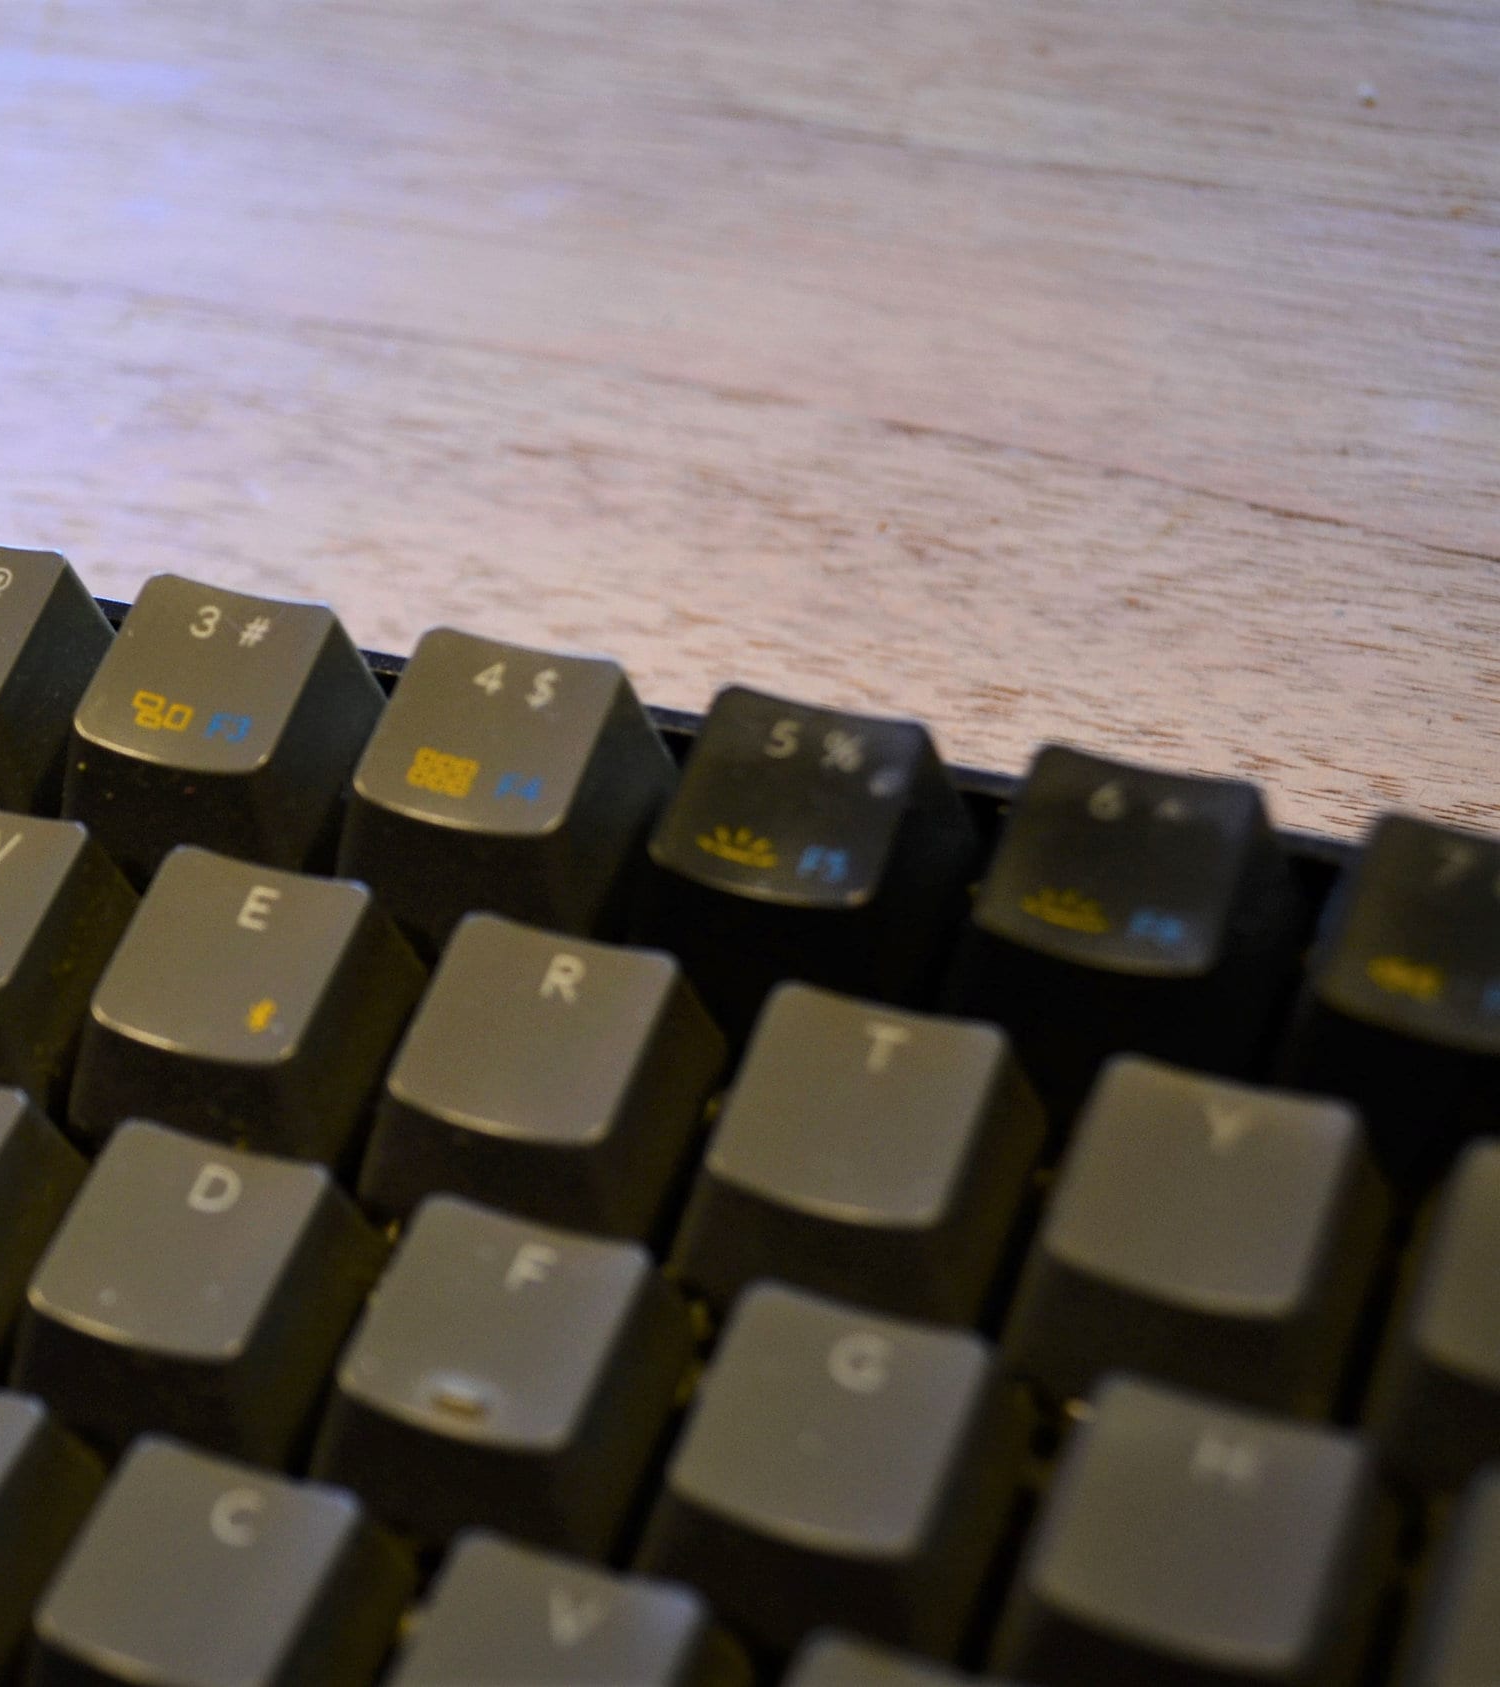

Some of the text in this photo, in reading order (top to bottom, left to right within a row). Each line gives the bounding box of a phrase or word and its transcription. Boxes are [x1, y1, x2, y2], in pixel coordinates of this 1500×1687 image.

[188, 604, 272, 648] 3 #
[473, 661, 560, 710] 4 $
[204, 711, 253, 743] F3
[762, 719, 801, 758] 5
[236, 884, 281, 931] E
[538, 953, 586, 1003] R
[864, 1021, 910, 1074] T
[185, 1163, 243, 1214] D
[505, 1242, 560, 1292] F
[208, 1486, 264, 1549] C
